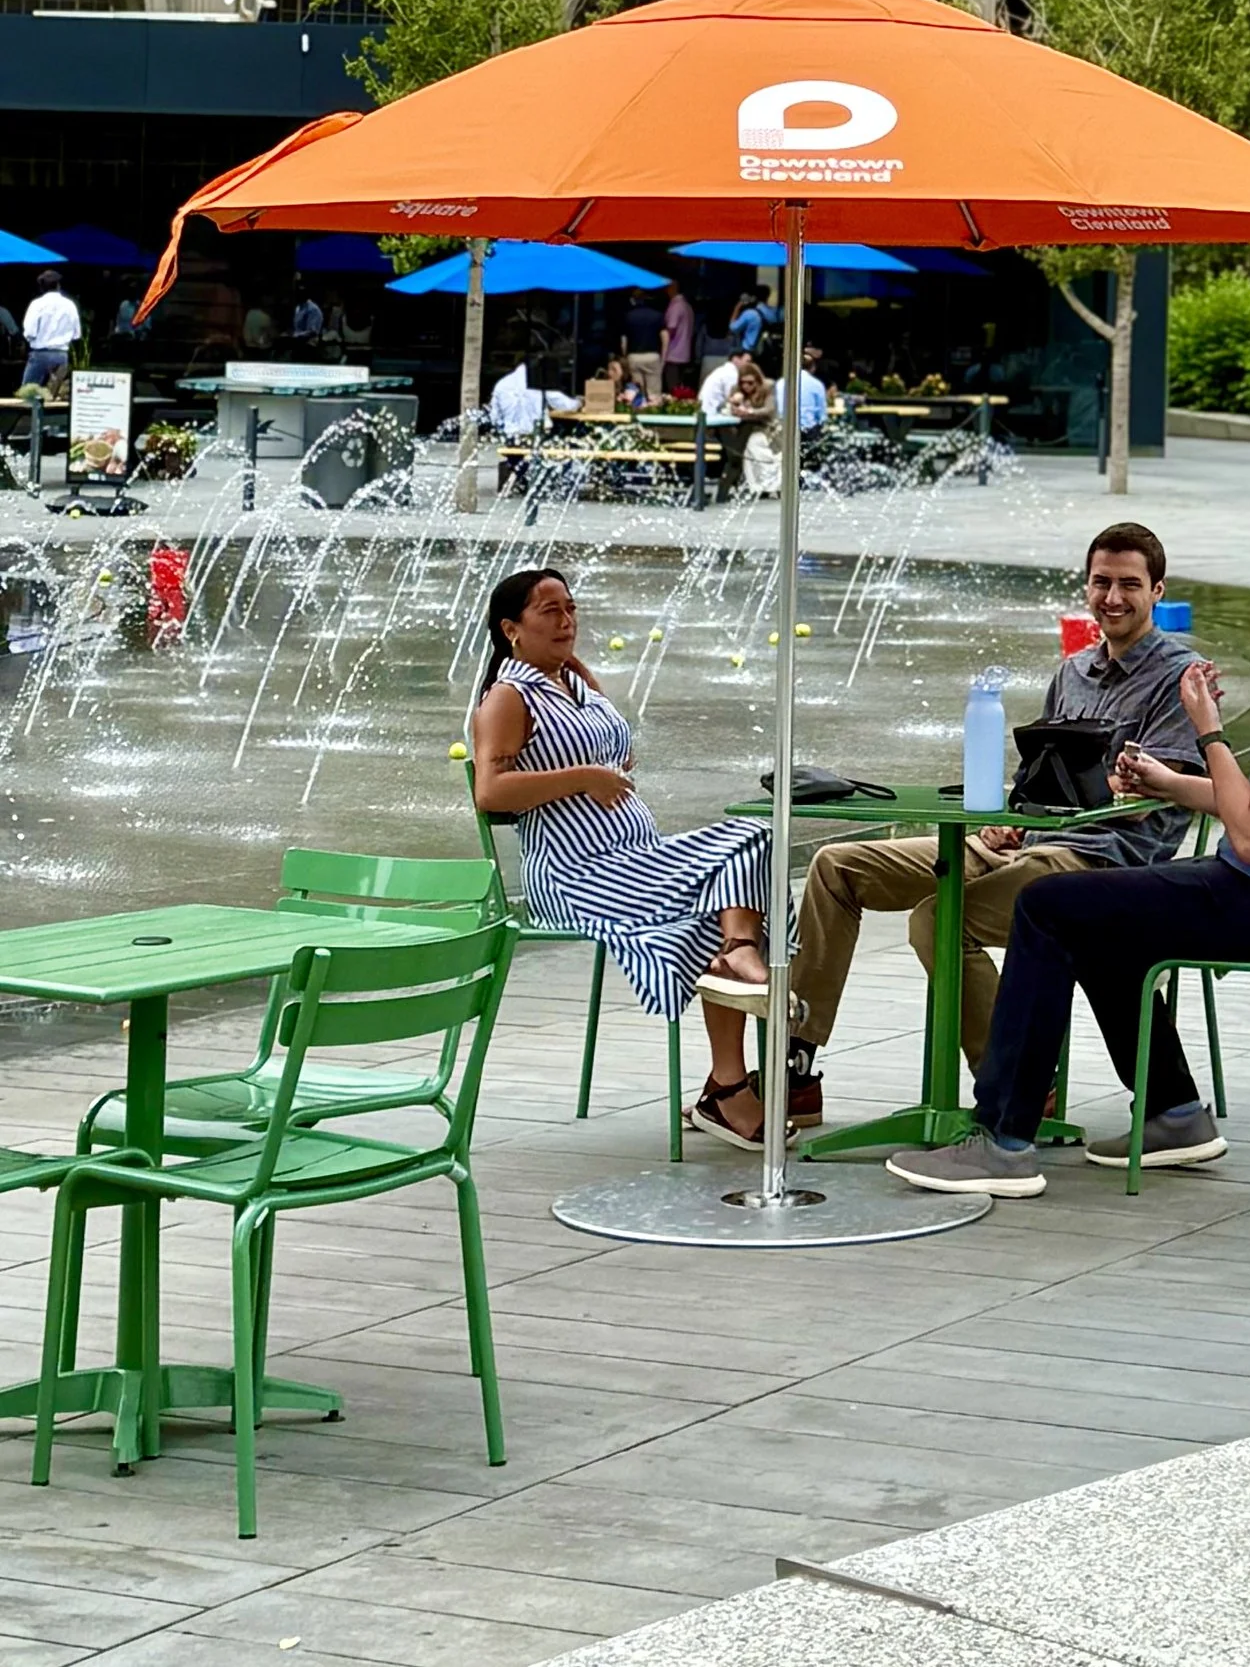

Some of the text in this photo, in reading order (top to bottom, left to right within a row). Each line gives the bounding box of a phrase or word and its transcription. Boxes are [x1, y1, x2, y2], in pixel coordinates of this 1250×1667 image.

[739, 155, 904, 170] Downtown
[739, 168, 892, 183] Cleveland
[389, 201, 479, 219] Square
[1070, 217, 1172, 231] Cleveland
